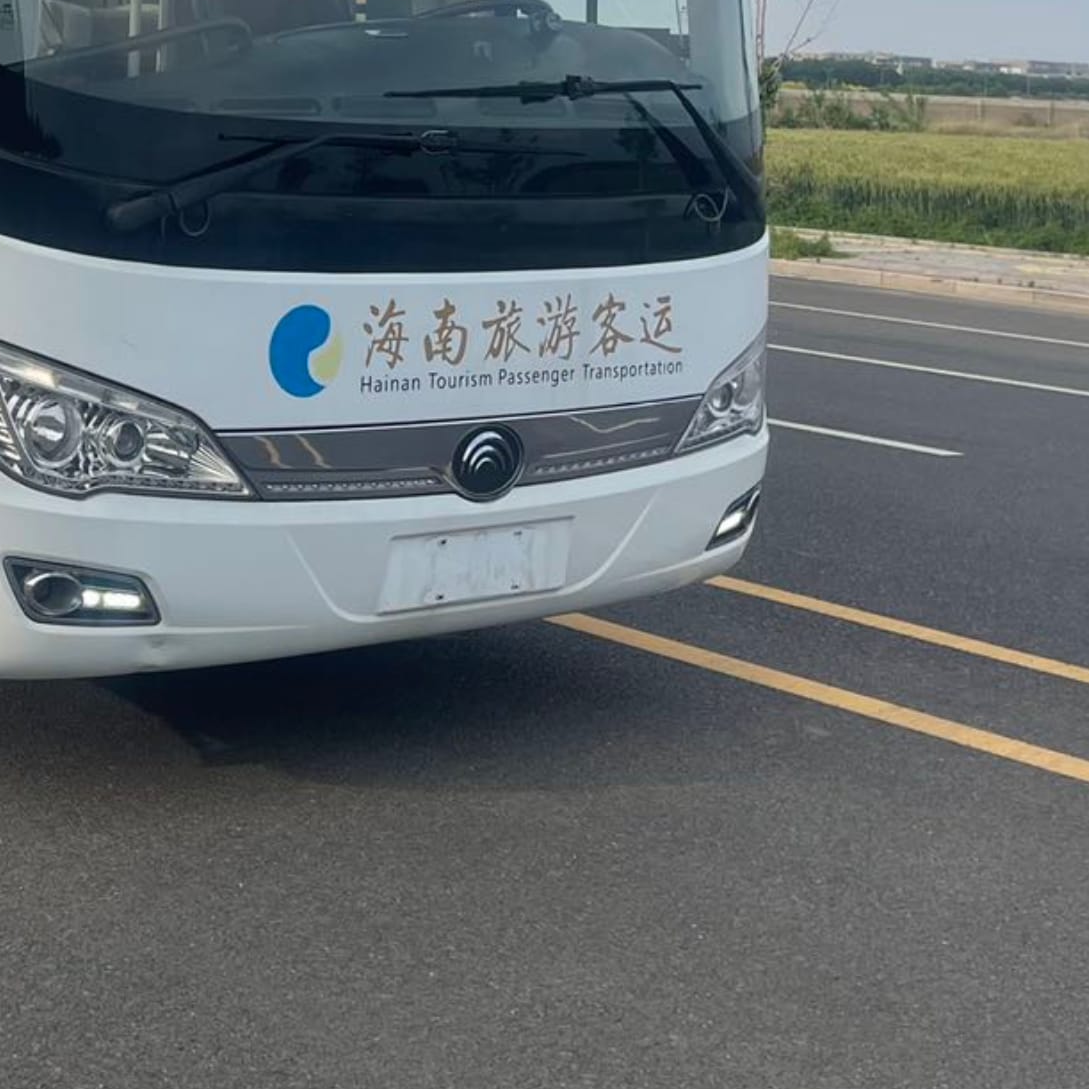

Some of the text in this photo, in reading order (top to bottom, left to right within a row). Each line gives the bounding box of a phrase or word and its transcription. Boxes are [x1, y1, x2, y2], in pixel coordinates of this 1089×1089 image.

[361, 291, 684, 369] 海南旅游客运
[360, 360, 684, 394] Hainan Tourism Passenger Transportation
